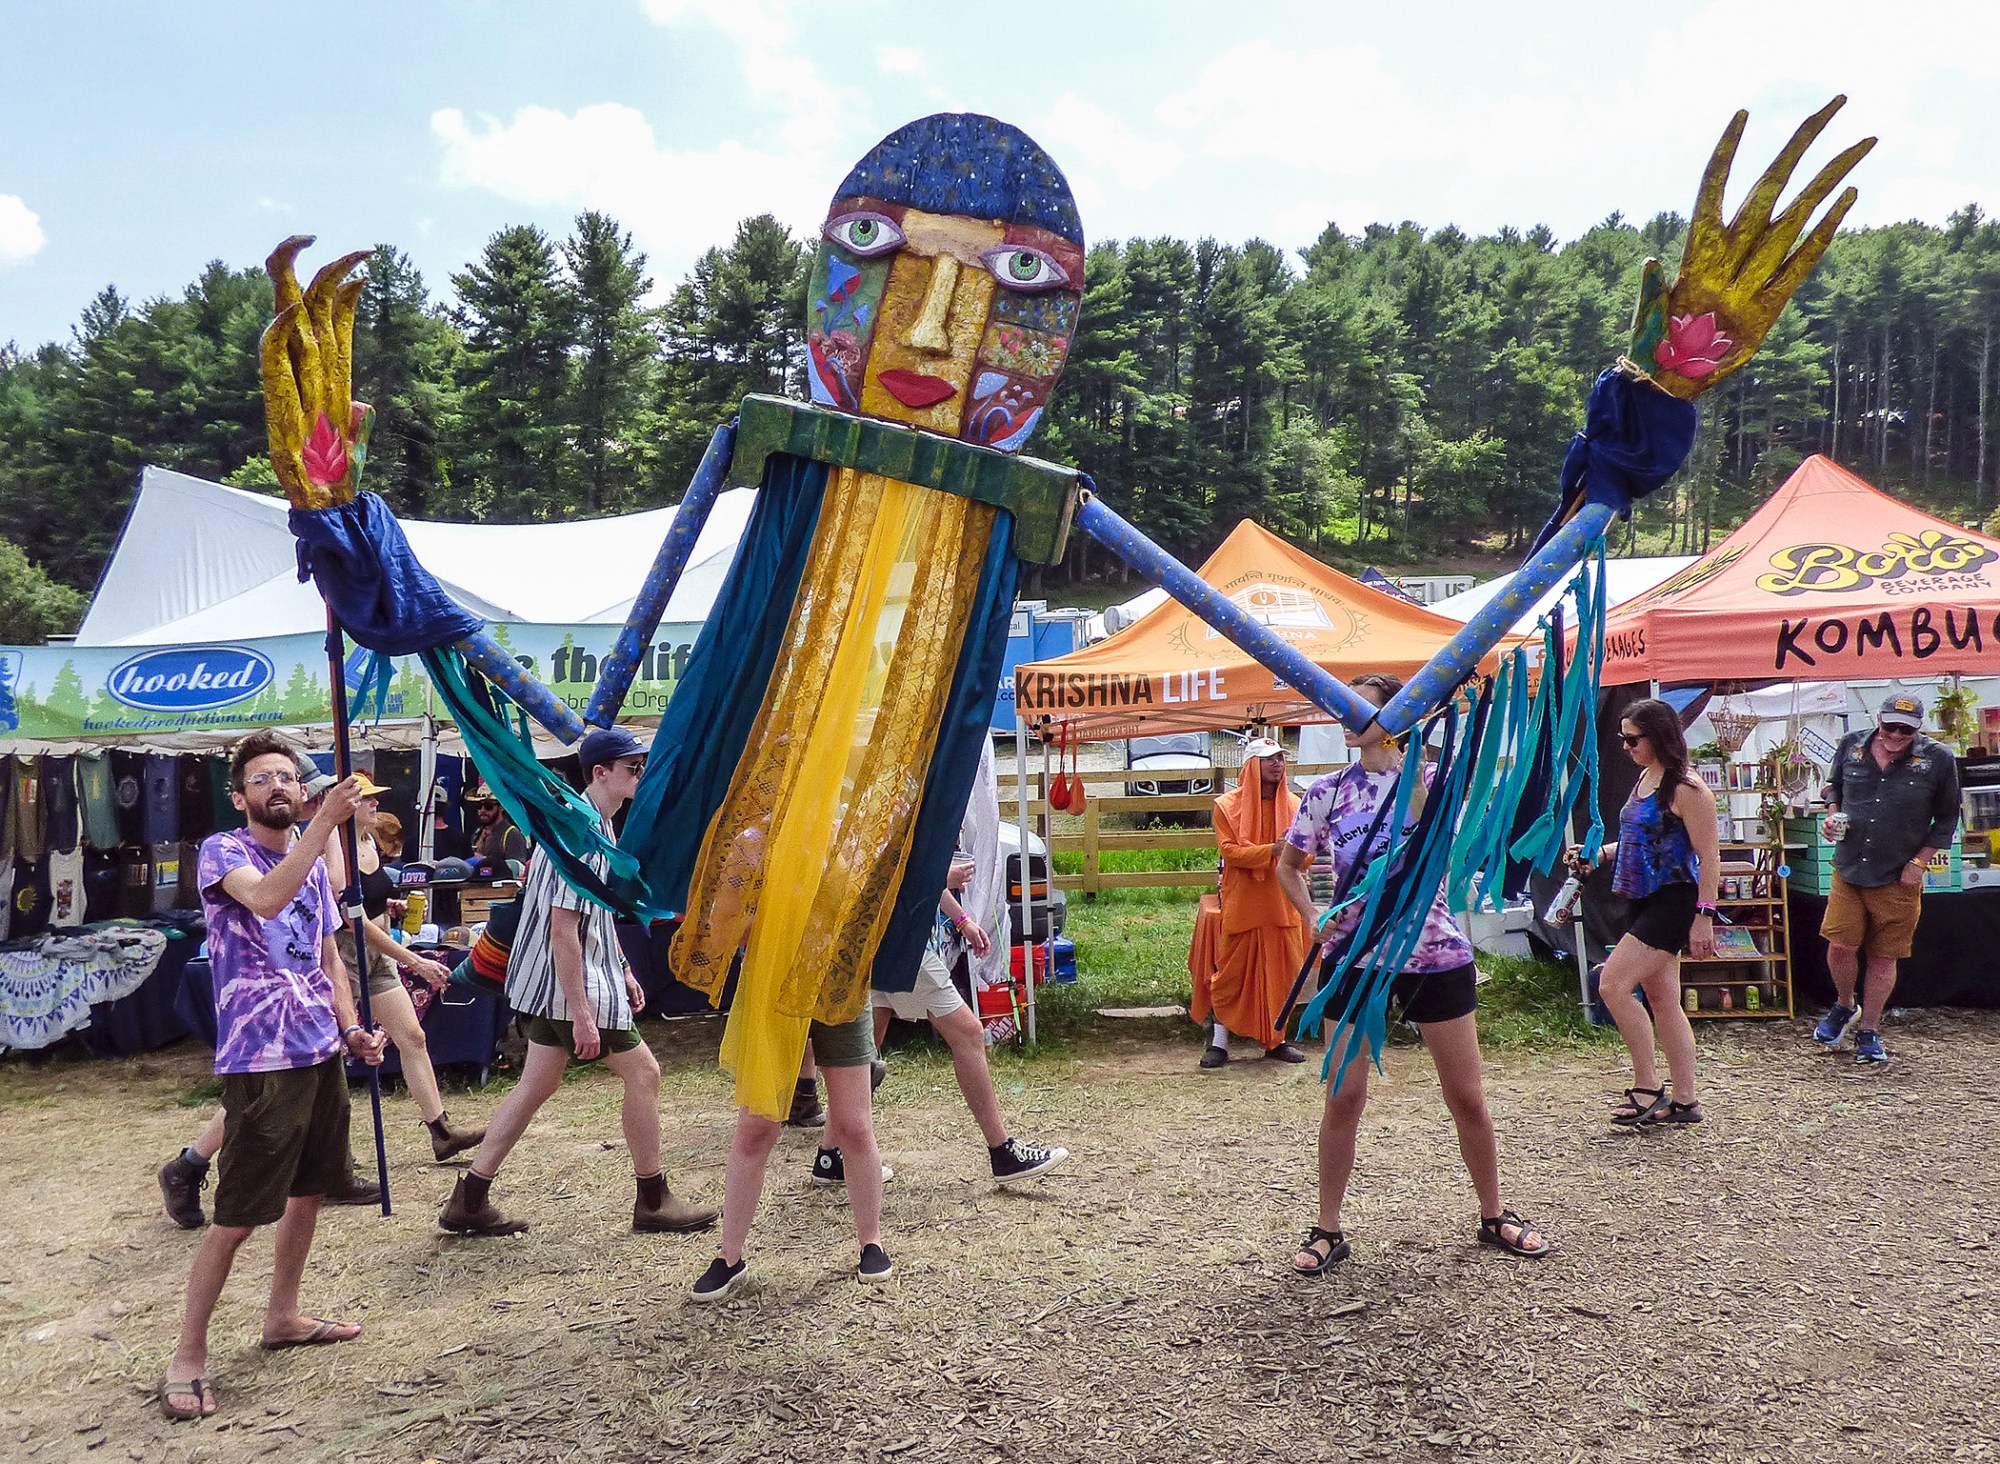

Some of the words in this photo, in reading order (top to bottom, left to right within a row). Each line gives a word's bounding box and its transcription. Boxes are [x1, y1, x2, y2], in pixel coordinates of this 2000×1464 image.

[1756, 530, 1998, 596] Boro
[1880, 573, 1985, 590] BEVERAGE
[1886, 582, 1992, 595] COMPANY
[118, 659, 257, 694] hooked
[1015, 671, 1153, 709] KRISHNA
[1162, 666, 1228, 703] LIFE
[83, 712, 284, 731] hookedproductions.com
